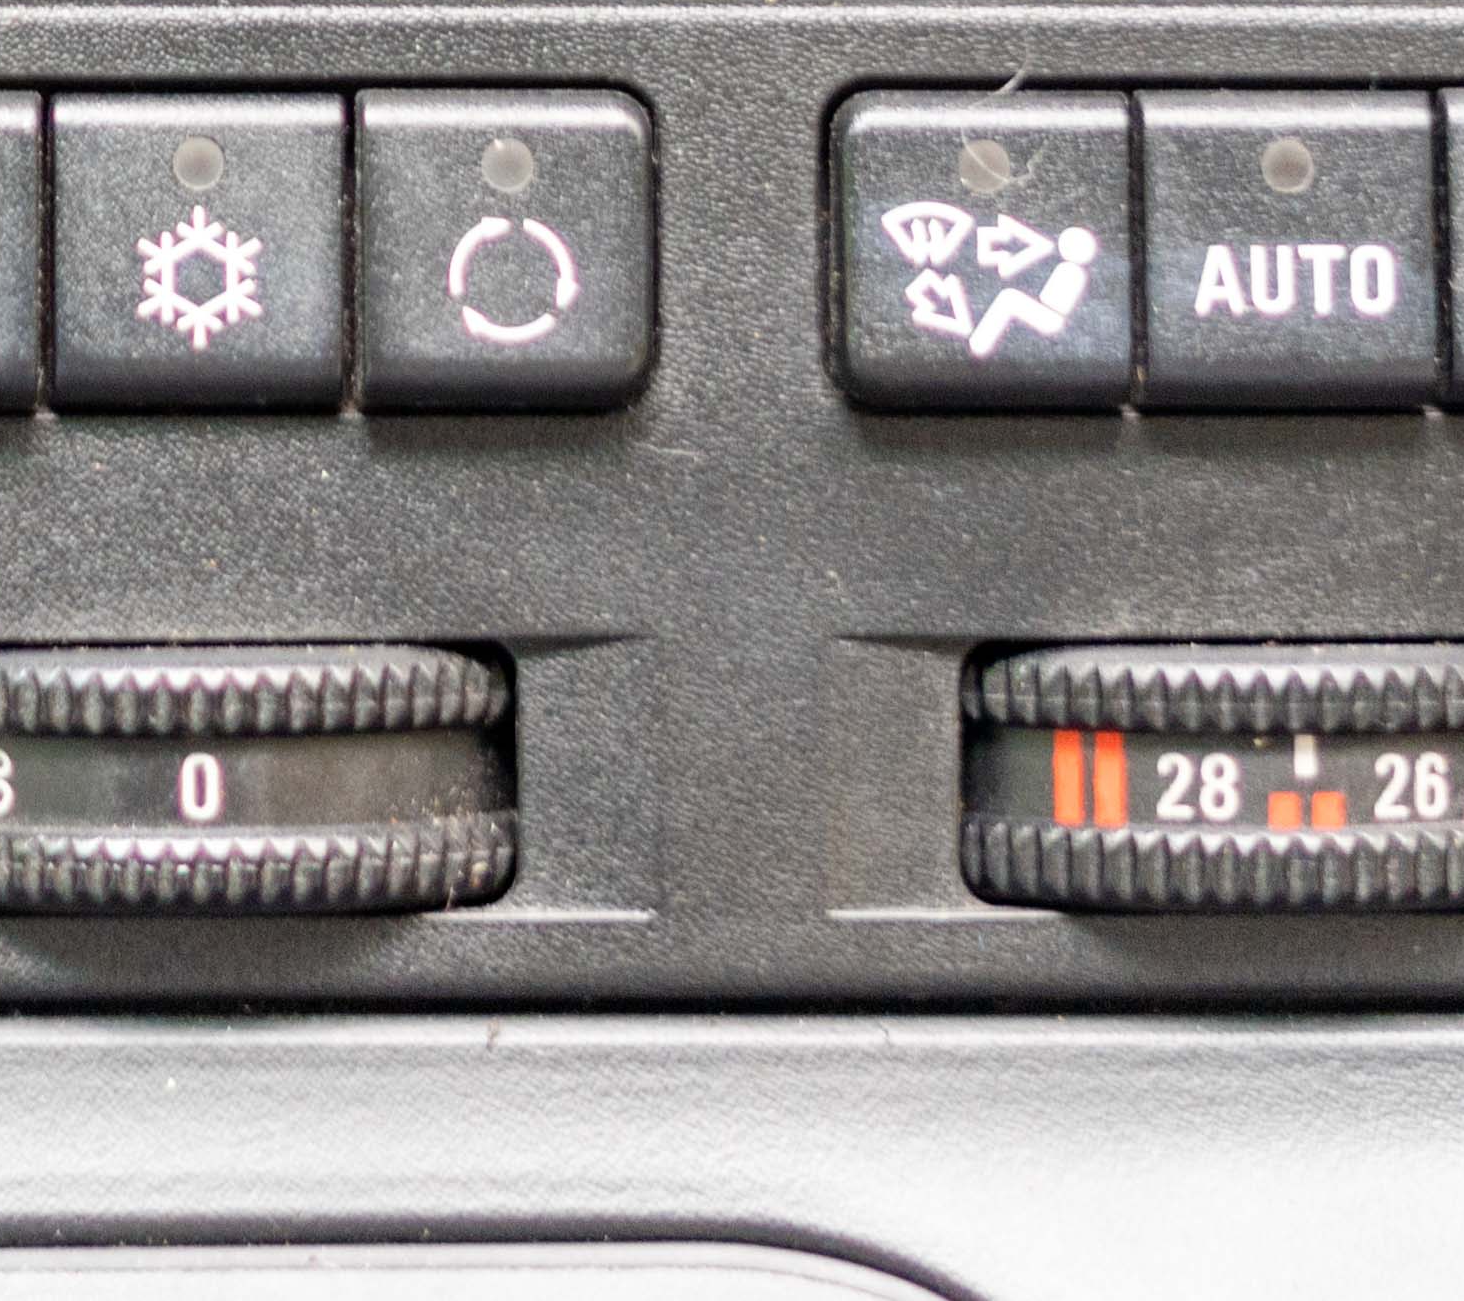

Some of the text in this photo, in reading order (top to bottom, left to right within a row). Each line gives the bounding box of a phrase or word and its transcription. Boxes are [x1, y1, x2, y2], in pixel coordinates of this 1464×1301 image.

[1194, 242, 1396, 318] AUTO
[178, 752, 224, 821] 0
[1155, 752, 1242, 821] 28
[1373, 752, 1450, 821] 26
